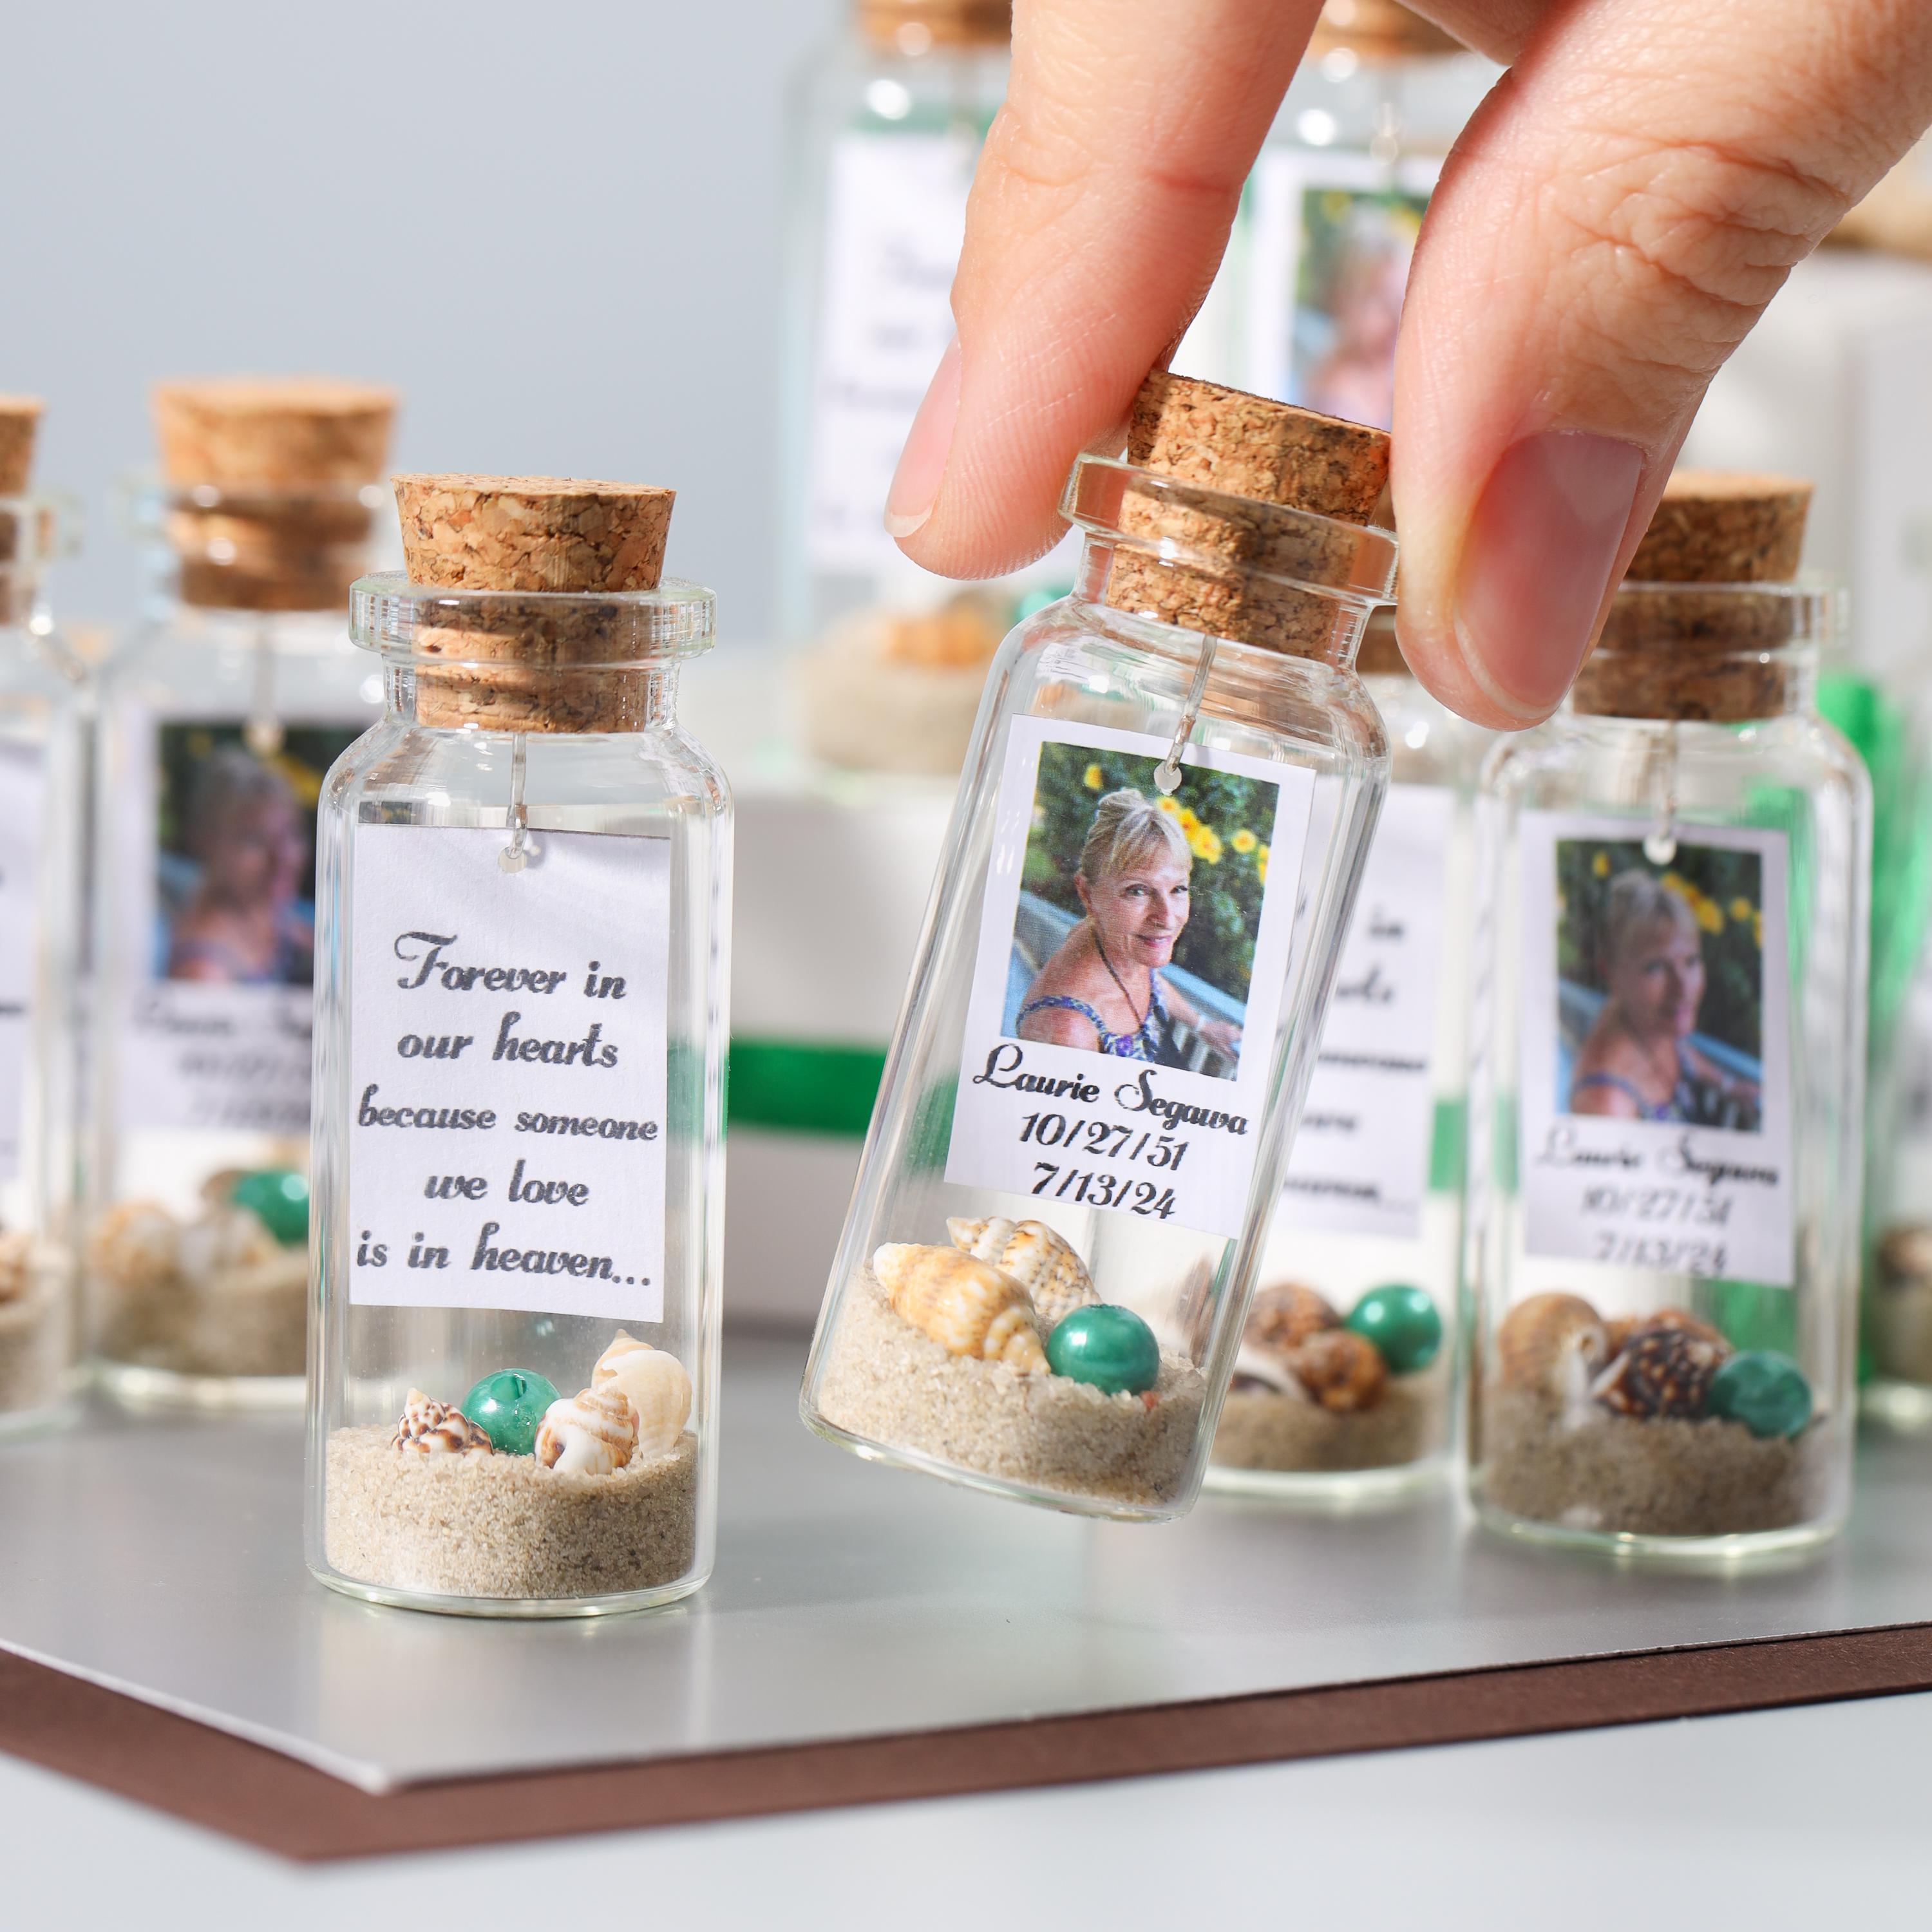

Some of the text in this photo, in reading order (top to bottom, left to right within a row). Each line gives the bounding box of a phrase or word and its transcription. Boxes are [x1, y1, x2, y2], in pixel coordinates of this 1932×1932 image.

[394, 932, 627, 999] Forever in
[397, 1011, 619, 1068] our hearts
[358, 1083, 658, 1141] because someone
[972, 1043, 1249, 1135] Laurie Segawa
[1019, 1112, 1190, 1171] 10/27/51
[424, 1159, 589, 1206] we love
[1031, 1162, 1177, 1220] 7/13/24
[357, 1222, 651, 1287] is in heaven...
